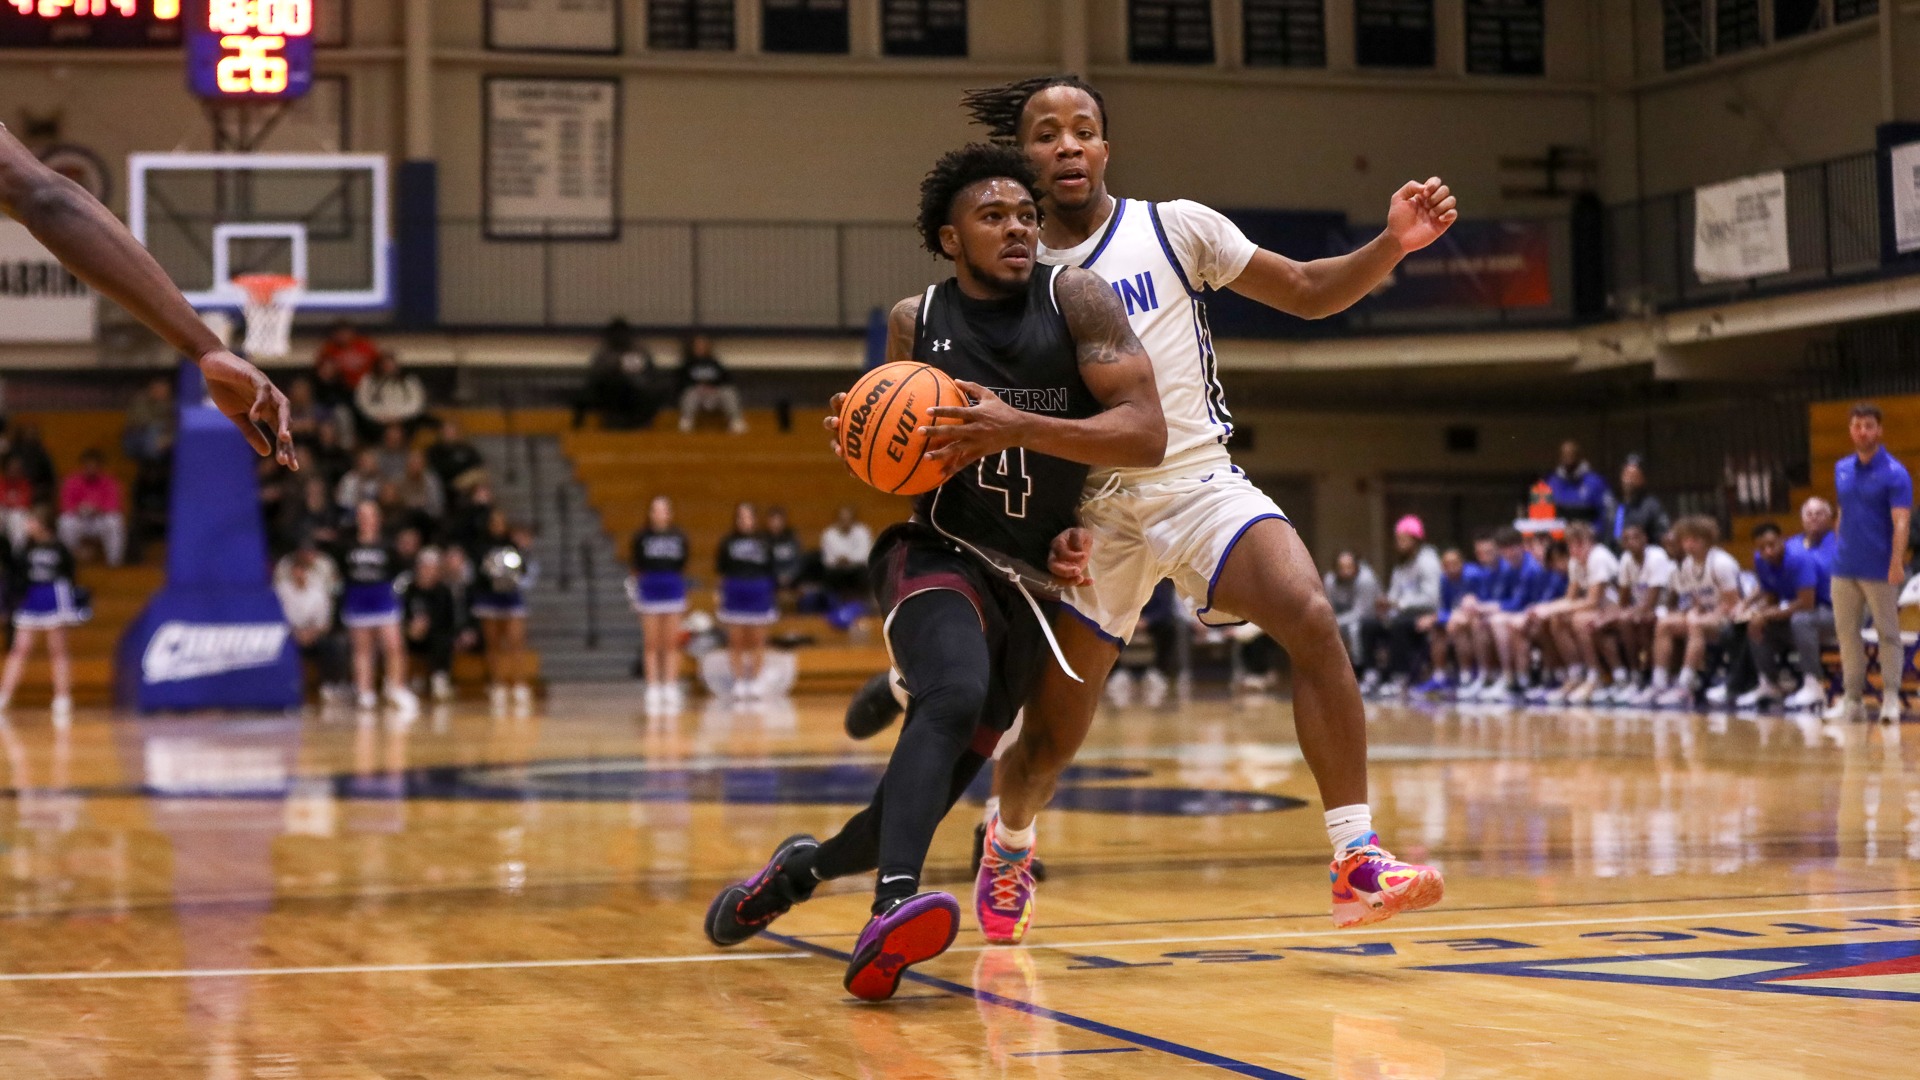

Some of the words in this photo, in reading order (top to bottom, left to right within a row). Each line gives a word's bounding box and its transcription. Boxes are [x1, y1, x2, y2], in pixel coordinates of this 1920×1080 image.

[217, 35, 288, 93] 26
[846, 378, 895, 460] Wilson
[978, 446, 1031, 518] 4
[1066, 937, 1544, 971] EAST
